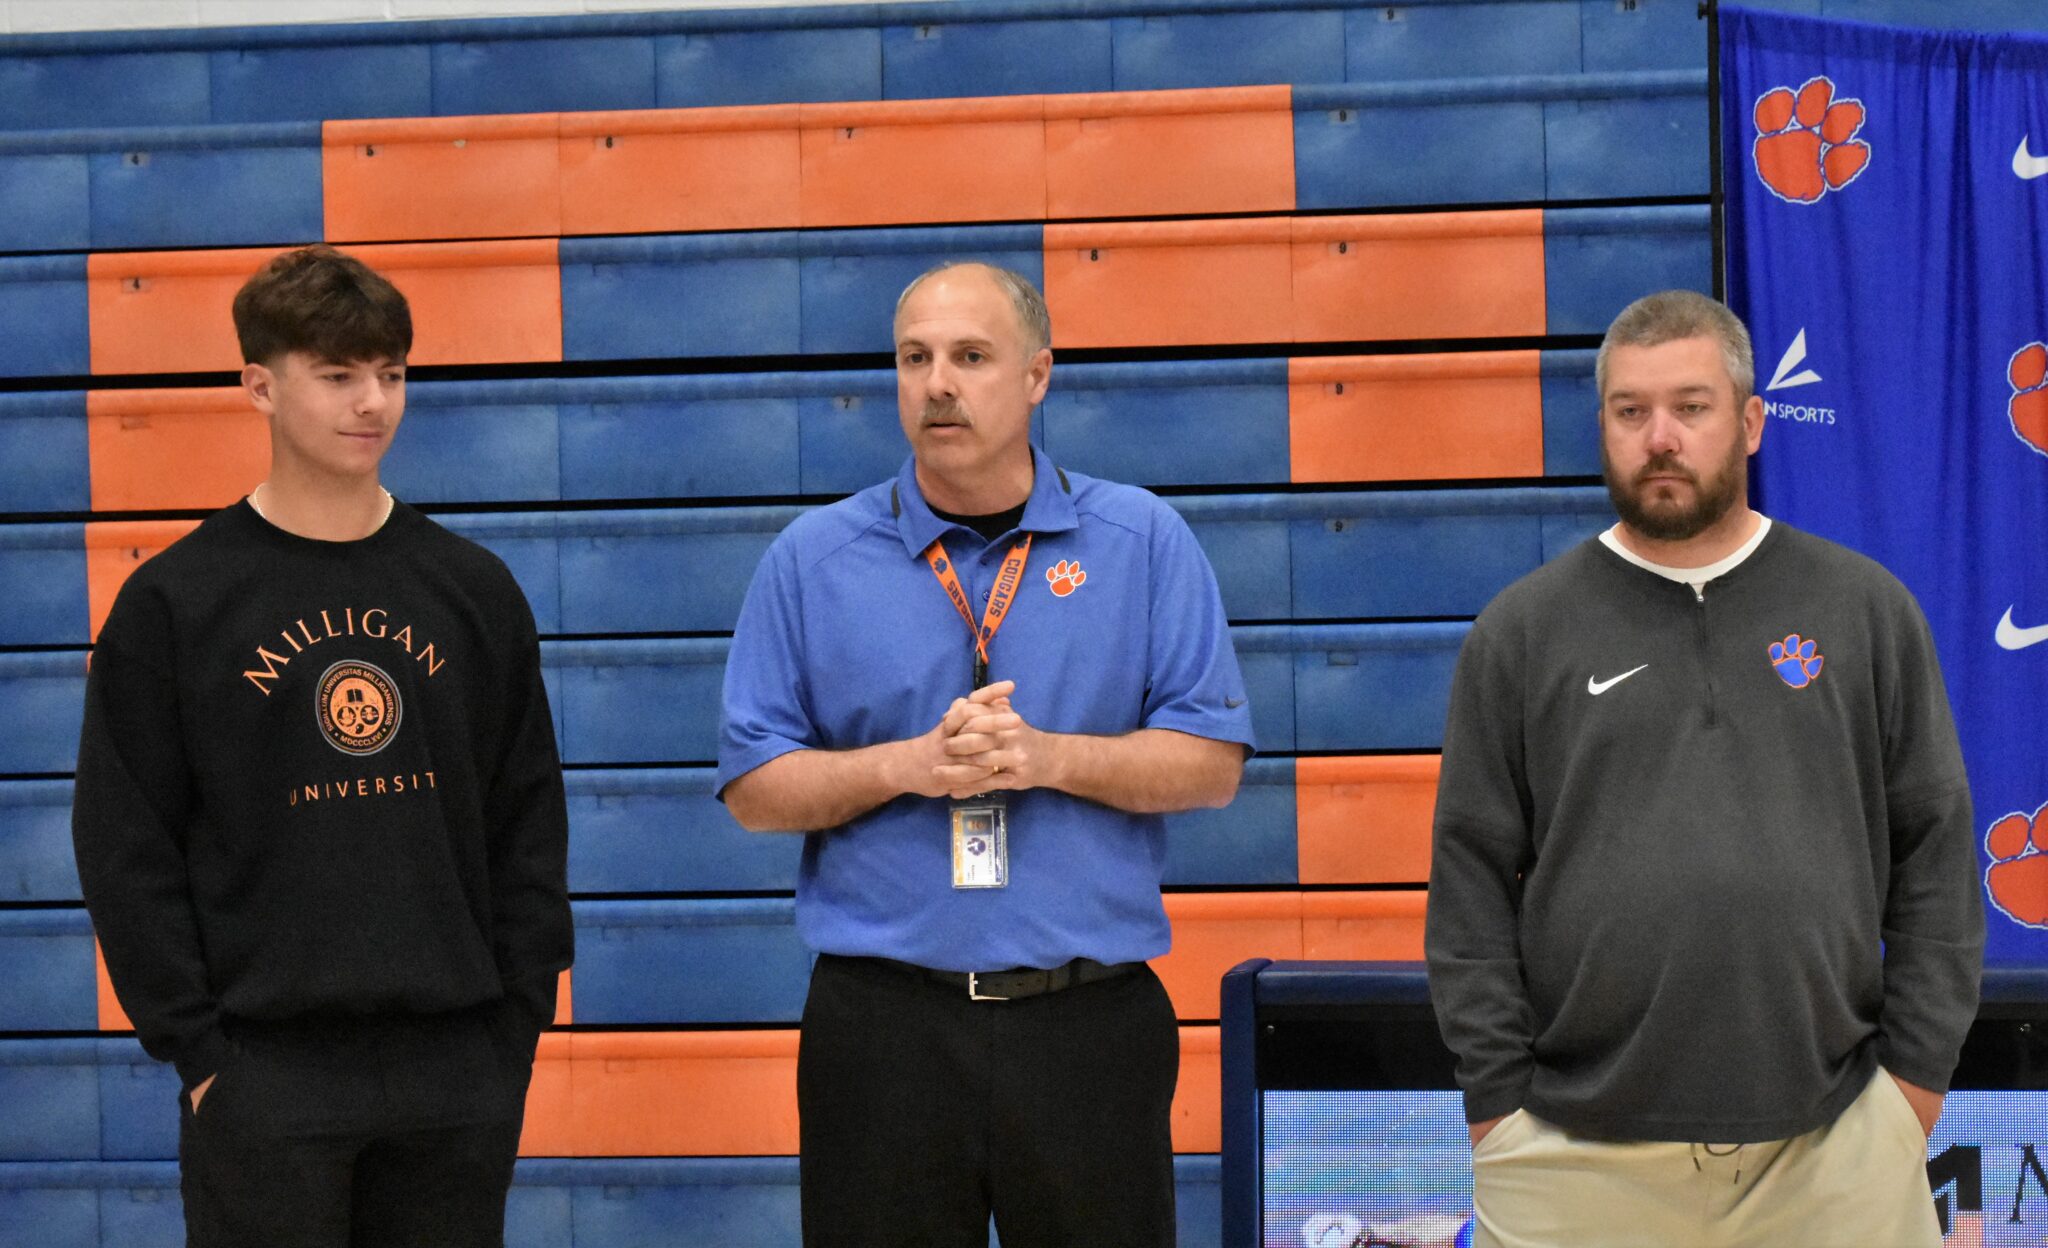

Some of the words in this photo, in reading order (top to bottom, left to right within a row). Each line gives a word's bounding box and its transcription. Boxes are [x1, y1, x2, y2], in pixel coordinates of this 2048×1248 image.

[846, 127, 853, 139] 7
[131, 154, 139, 165] 4
[1339, 242, 1347, 254] 9
[1091, 249, 1099, 261] 8
[133, 277, 140, 289] 4
[1335, 383, 1343, 395] 9
[844, 398, 851, 409] 7
[1335, 520, 1343, 532] 9
[132, 547, 139, 559] 4
[990, 558, 1021, 618] COUGARS
[242, 607, 446, 696] MILLIGAN
[324, 668, 362, 694] UNIVERSITAS
[290, 771, 436, 806] UNIVERSIT
